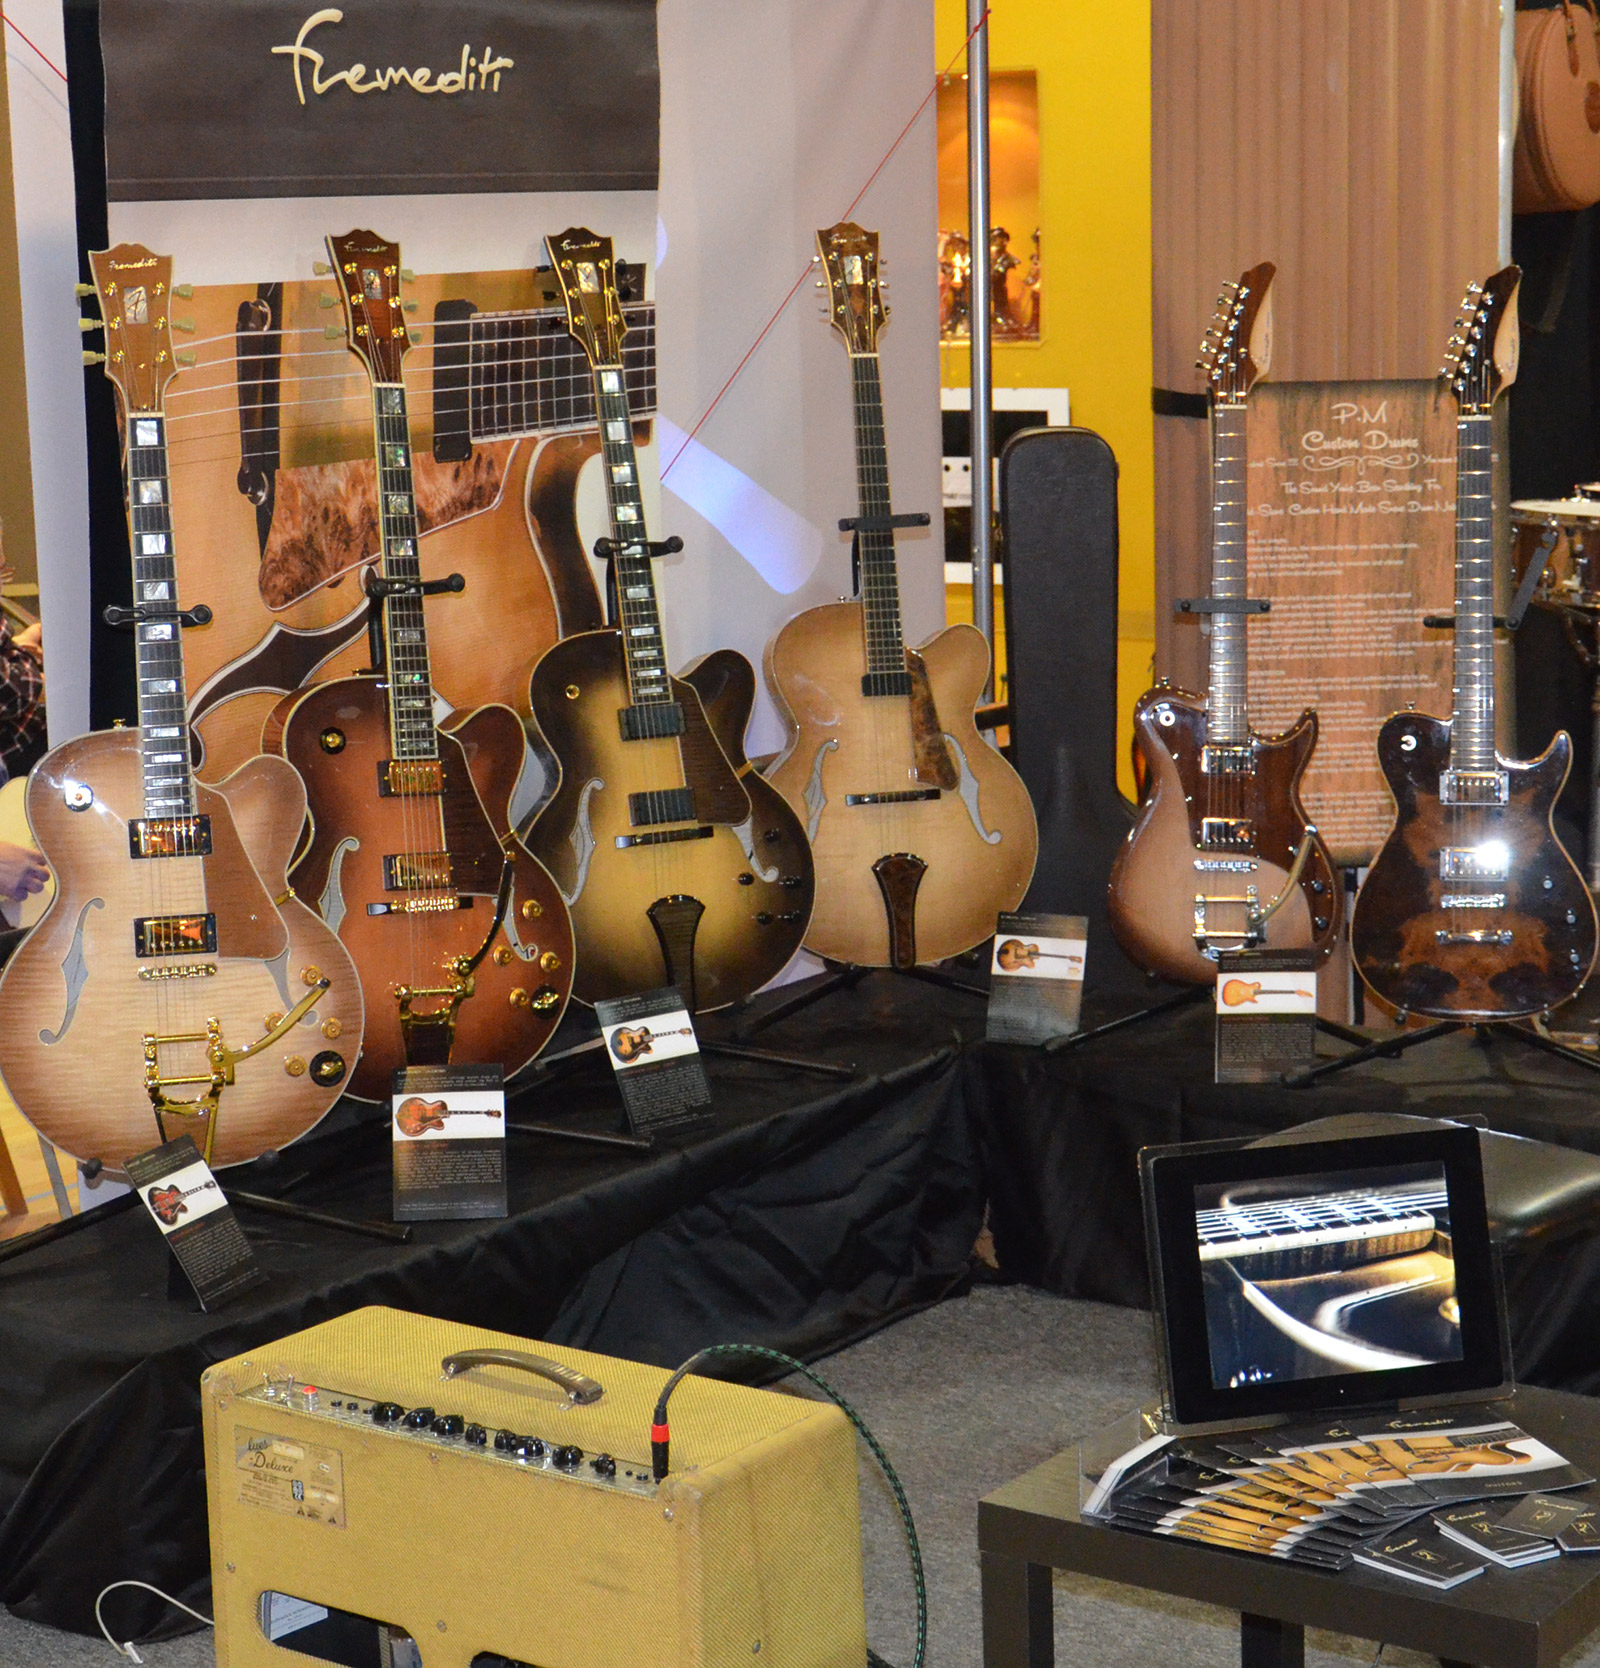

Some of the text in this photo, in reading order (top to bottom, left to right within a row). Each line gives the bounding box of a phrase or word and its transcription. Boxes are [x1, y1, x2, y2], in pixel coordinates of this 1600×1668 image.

[1302, 430, 1419, 451] Custom Drums
[254, 1451, 293, 1473] Deluxe
